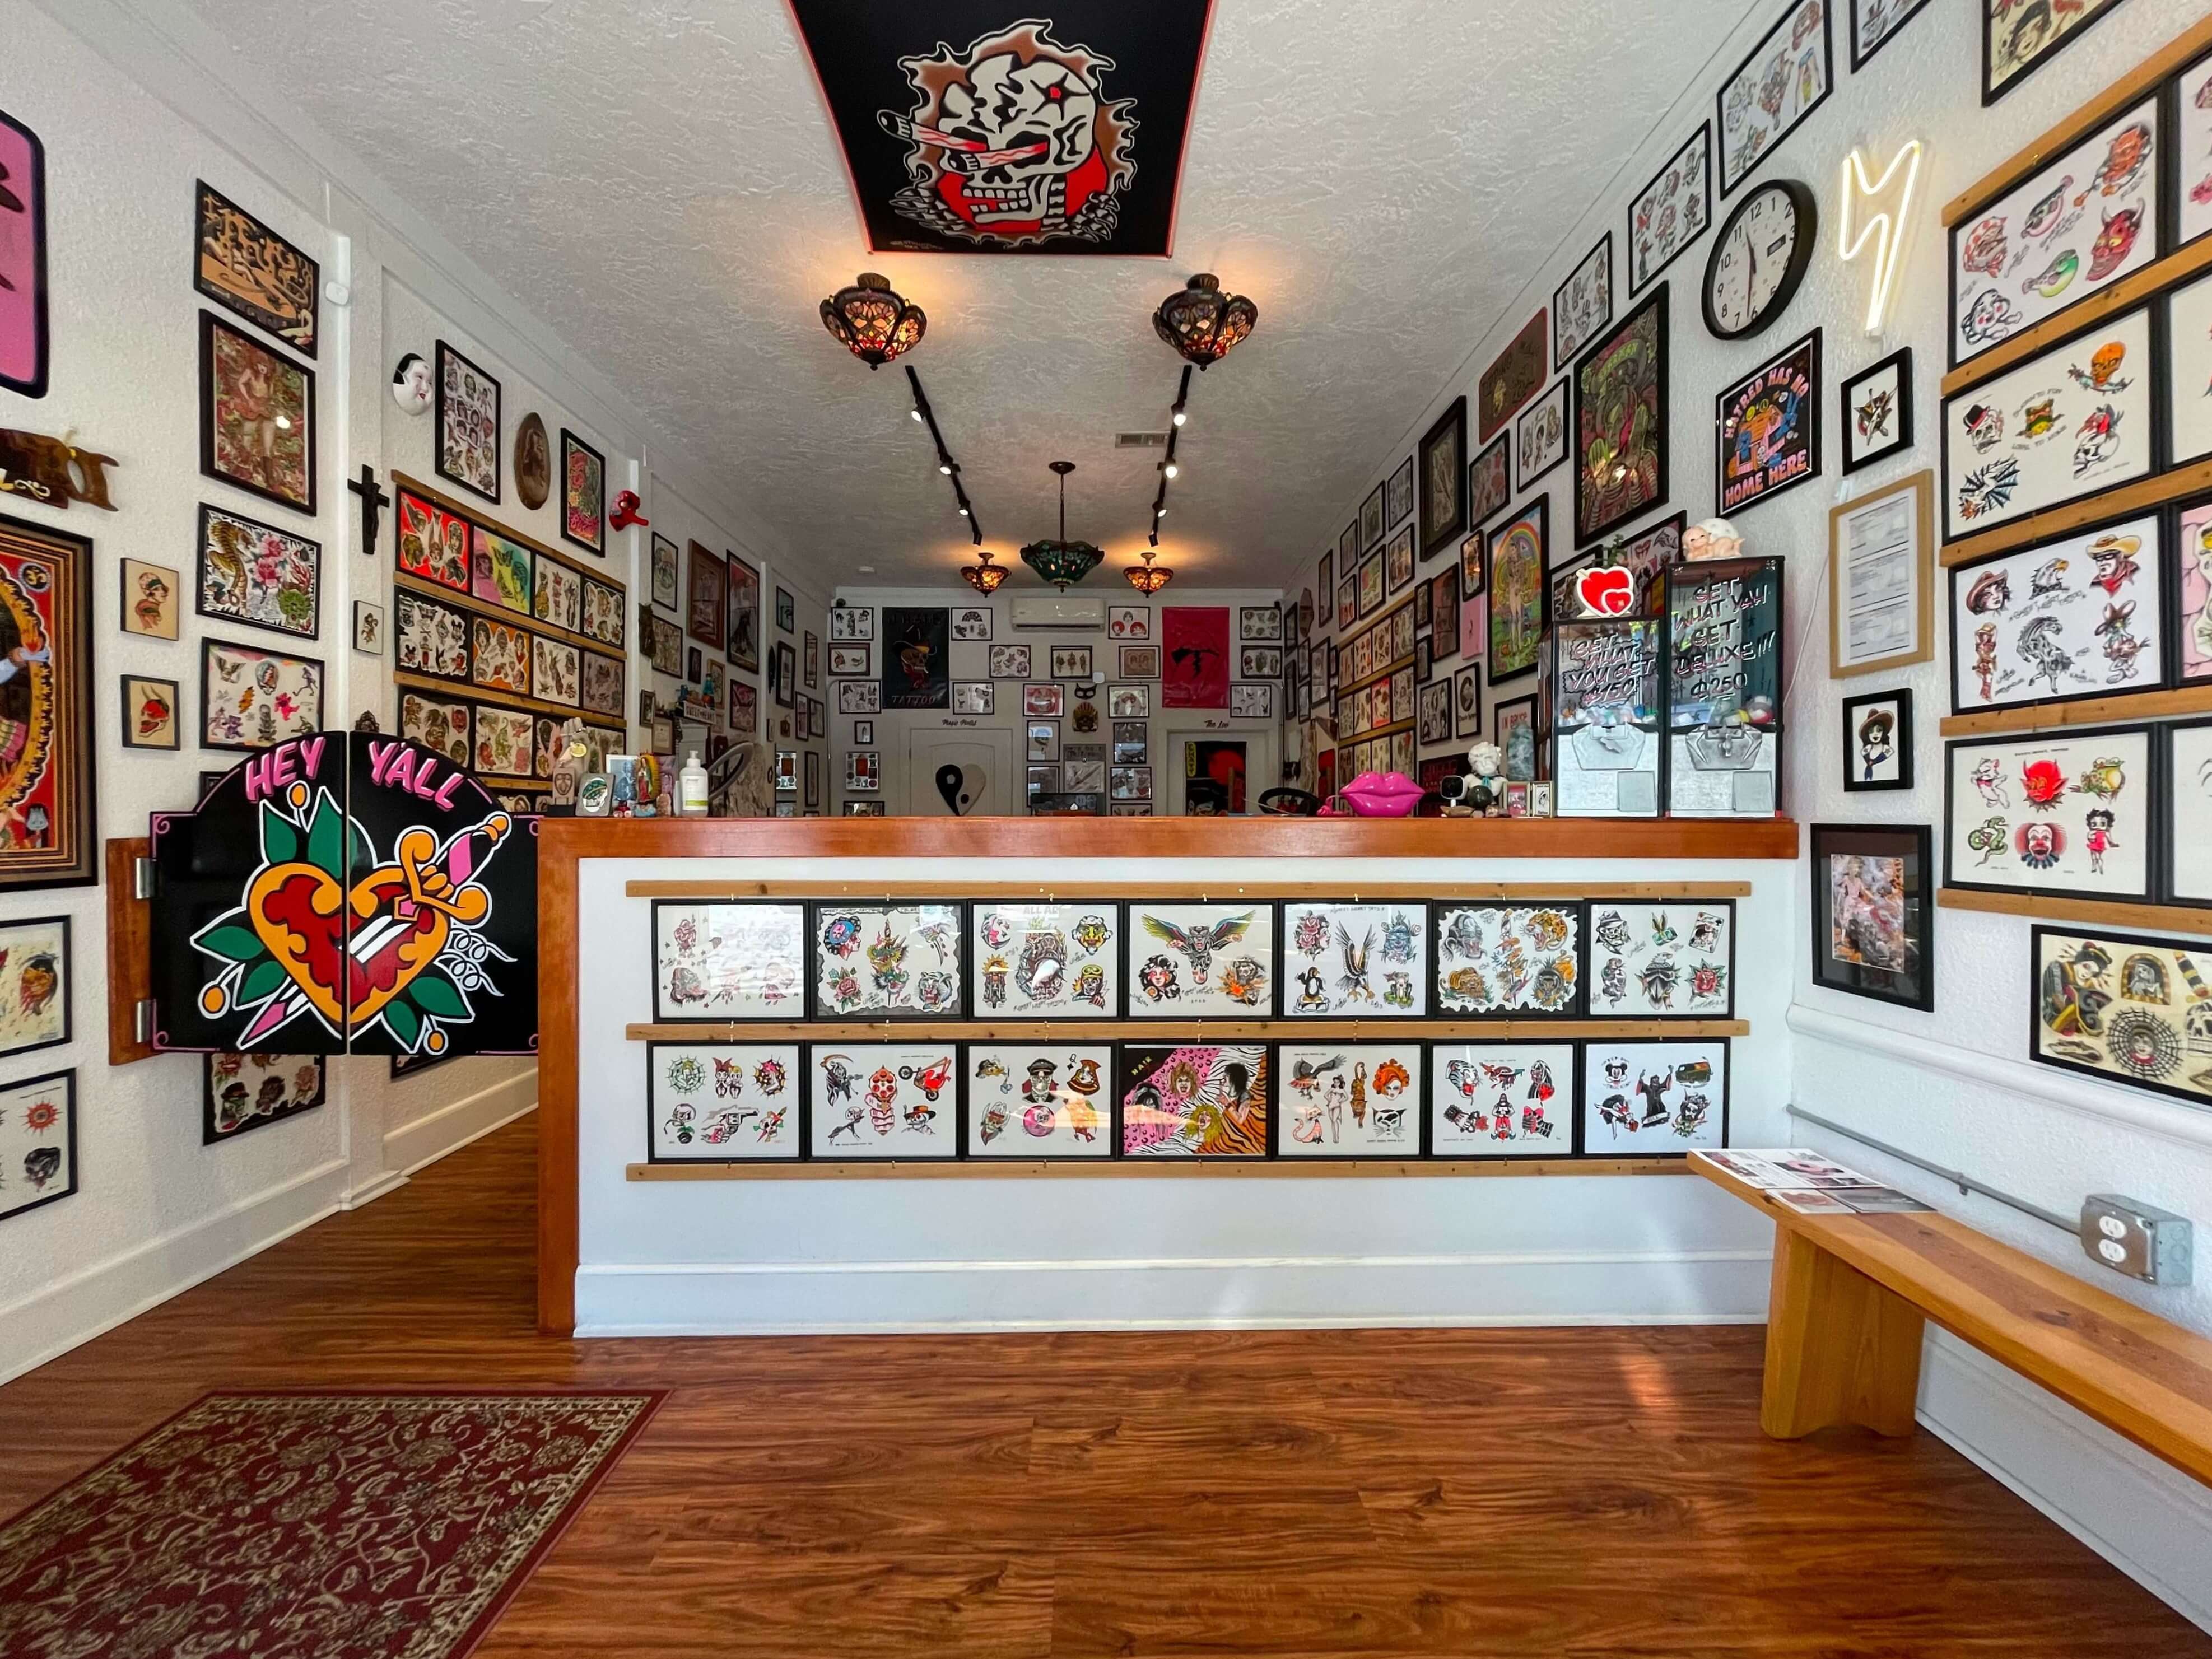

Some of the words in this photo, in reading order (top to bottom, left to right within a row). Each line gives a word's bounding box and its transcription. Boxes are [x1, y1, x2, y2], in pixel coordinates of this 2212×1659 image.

[1750, 202, 1762, 222] 12
[1771, 197, 1776, 211] 1
[1784, 201, 1792, 219] 2
[1734, 225, 1742, 243] 11
[1720, 253, 1731, 272] 10
[1717, 282, 1724, 297] 9
[1721, 303, 1727, 318] 8
[1734, 311, 1740, 328] 7
[1751, 306, 1758, 321] 6
[1725, 378, 1763, 438] HATRED
[1767, 366, 1793, 387] HAS
[1791, 373, 1809, 398] NO
[1725, 471, 1764, 507] HOME
[1768, 449, 1807, 486] HERE
[1693, 577, 1740, 603] GET
[1675, 599, 1726, 631] WHAT
[1691, 619, 1739, 647] GET
[1574, 632, 1618, 659] GET
[1586, 644, 1642, 671] WHAT
[1569, 667, 1611, 689] YOU
[1614, 658, 1655, 681] GET
[1691, 672, 1748, 700] $250
[892, 695, 935, 705] TATTOO
[245, 736, 326, 804] HEY
[368, 740, 465, 812] Y'ALL
[1069, 1053, 1077, 1064] Q
[1131, 1056, 1152, 1075] HAIR
